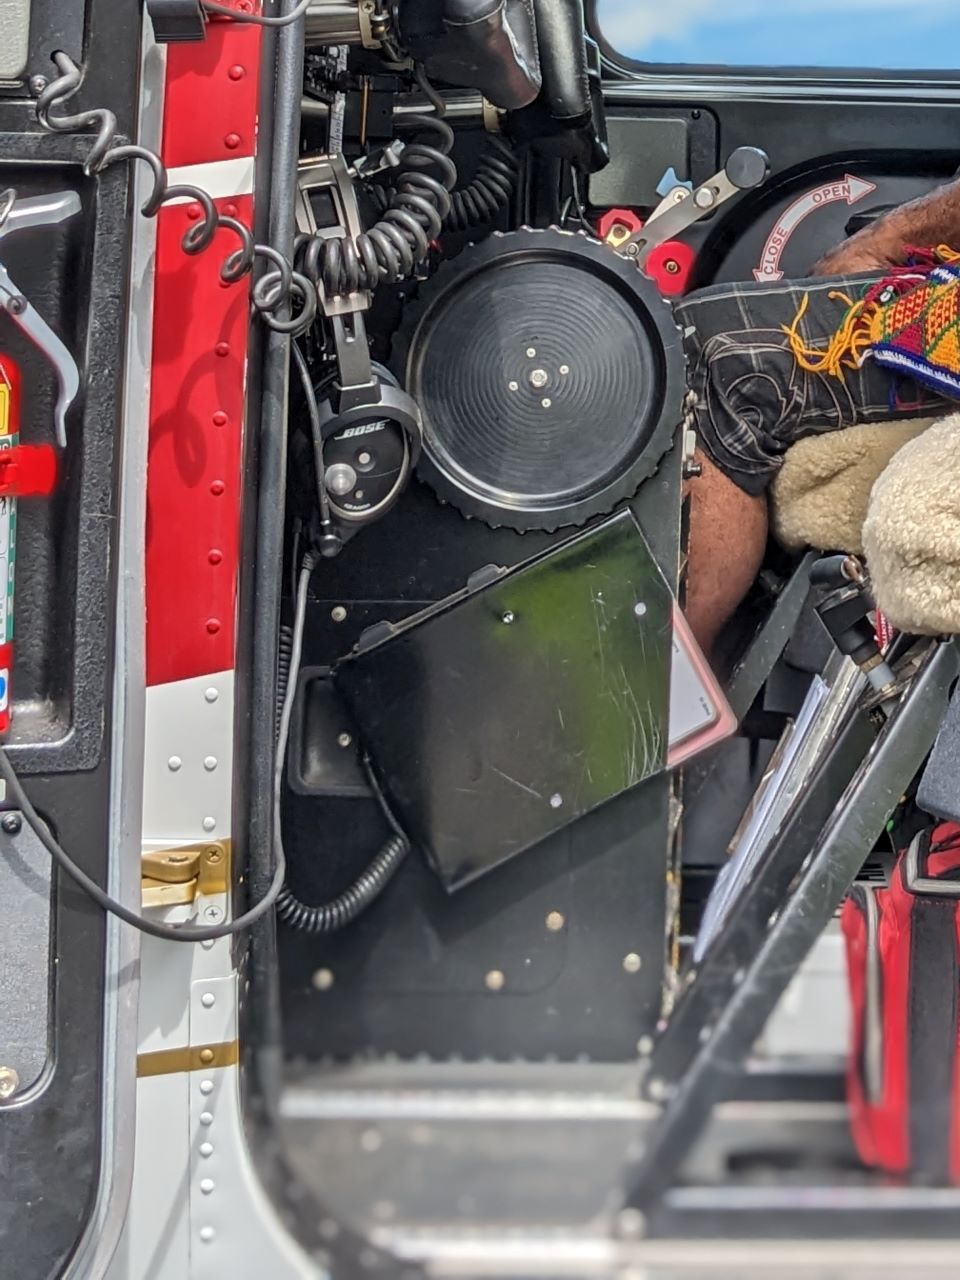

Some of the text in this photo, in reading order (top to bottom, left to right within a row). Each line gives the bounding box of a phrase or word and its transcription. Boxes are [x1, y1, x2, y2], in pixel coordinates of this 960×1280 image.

[811, 184, 851, 203] OPEN
[763, 227, 788, 275] CLOSE
[336, 420, 389, 439] BOSE
